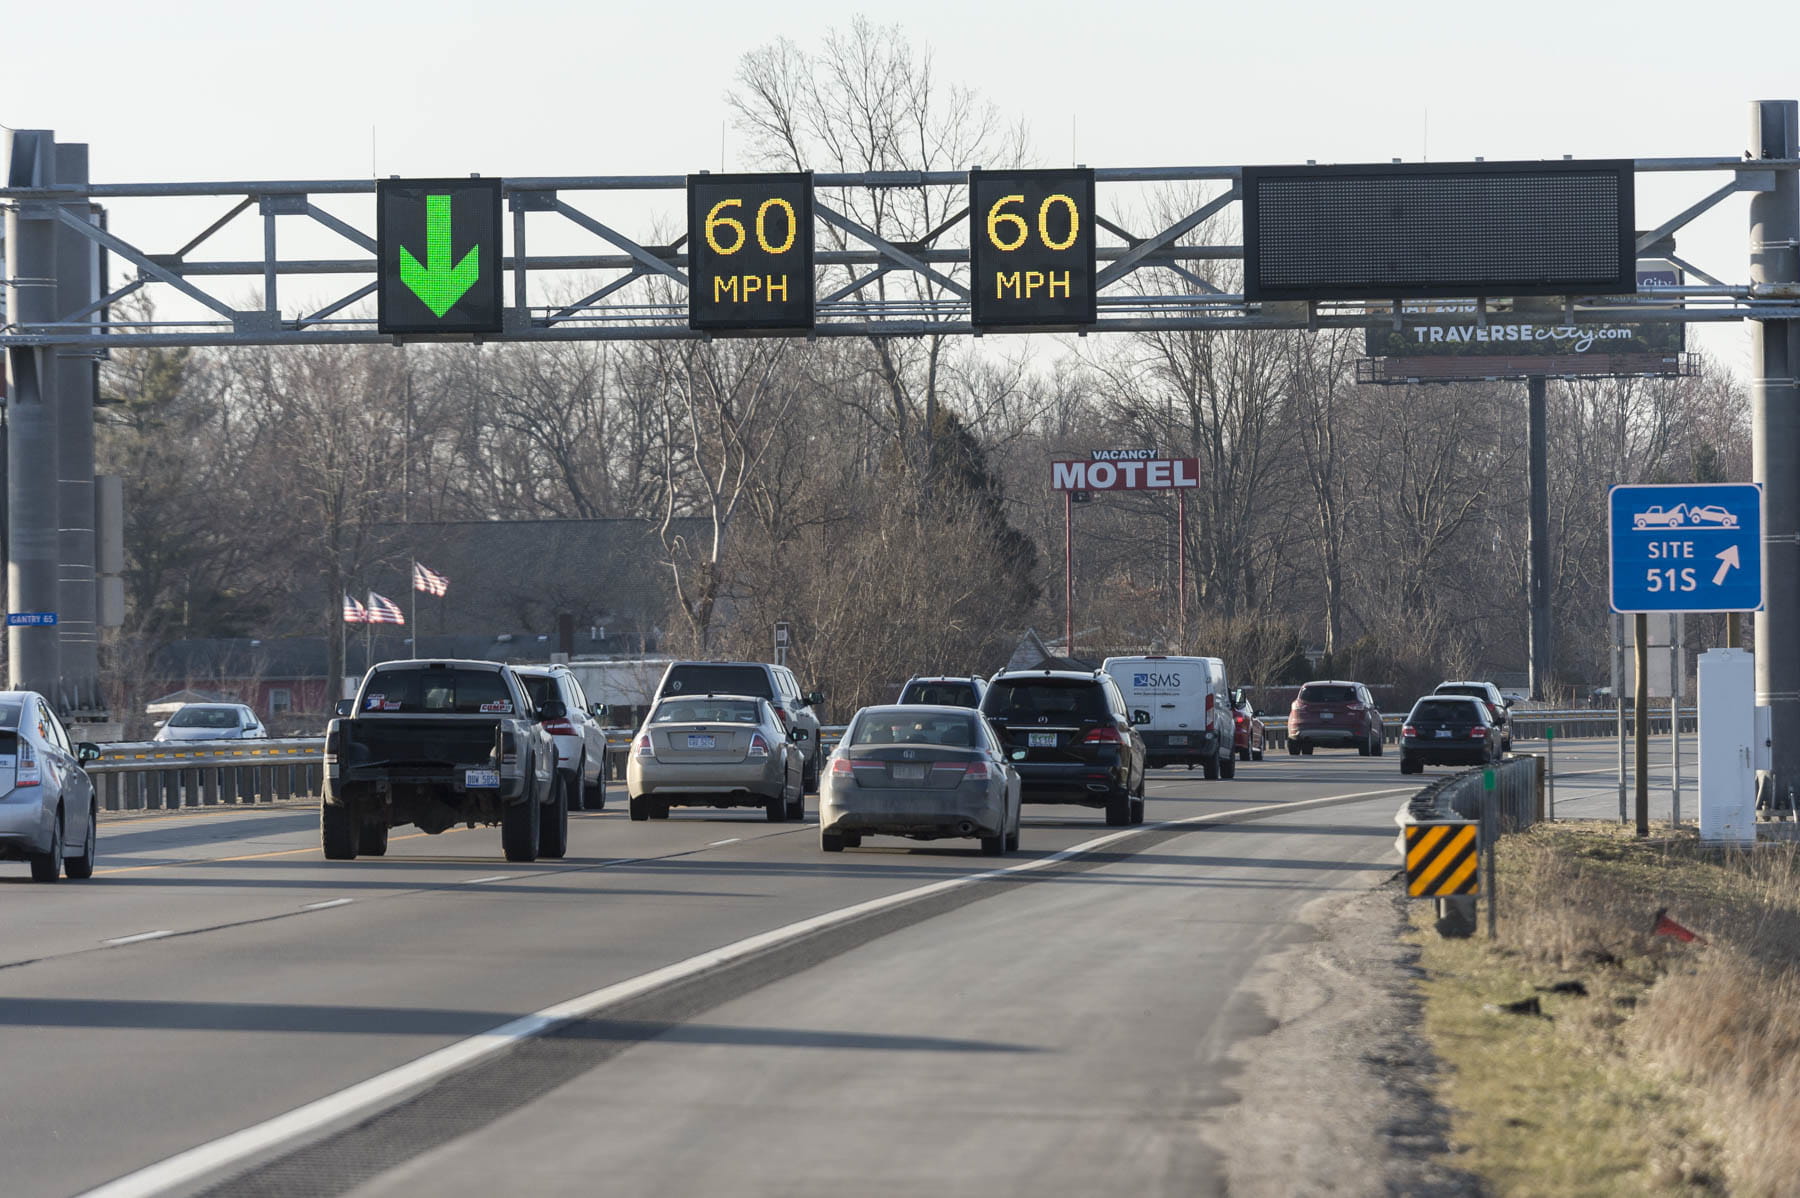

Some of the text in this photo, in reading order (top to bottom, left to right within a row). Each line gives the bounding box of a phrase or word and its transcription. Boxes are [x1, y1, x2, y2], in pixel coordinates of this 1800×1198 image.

[706, 199, 796, 254] 60
[987, 195, 1079, 251] 60
[715, 275, 787, 302] MPH
[997, 271, 1070, 299] MPH
[1093, 450, 1157, 460] VACANCY
[1053, 461, 1197, 489] MOTEL
[1648, 541, 1694, 559] SITE
[1647, 568, 1697, 592] 51S
[10, 615, 41, 624] GANTRY
[1149, 673, 1181, 688] SMS
